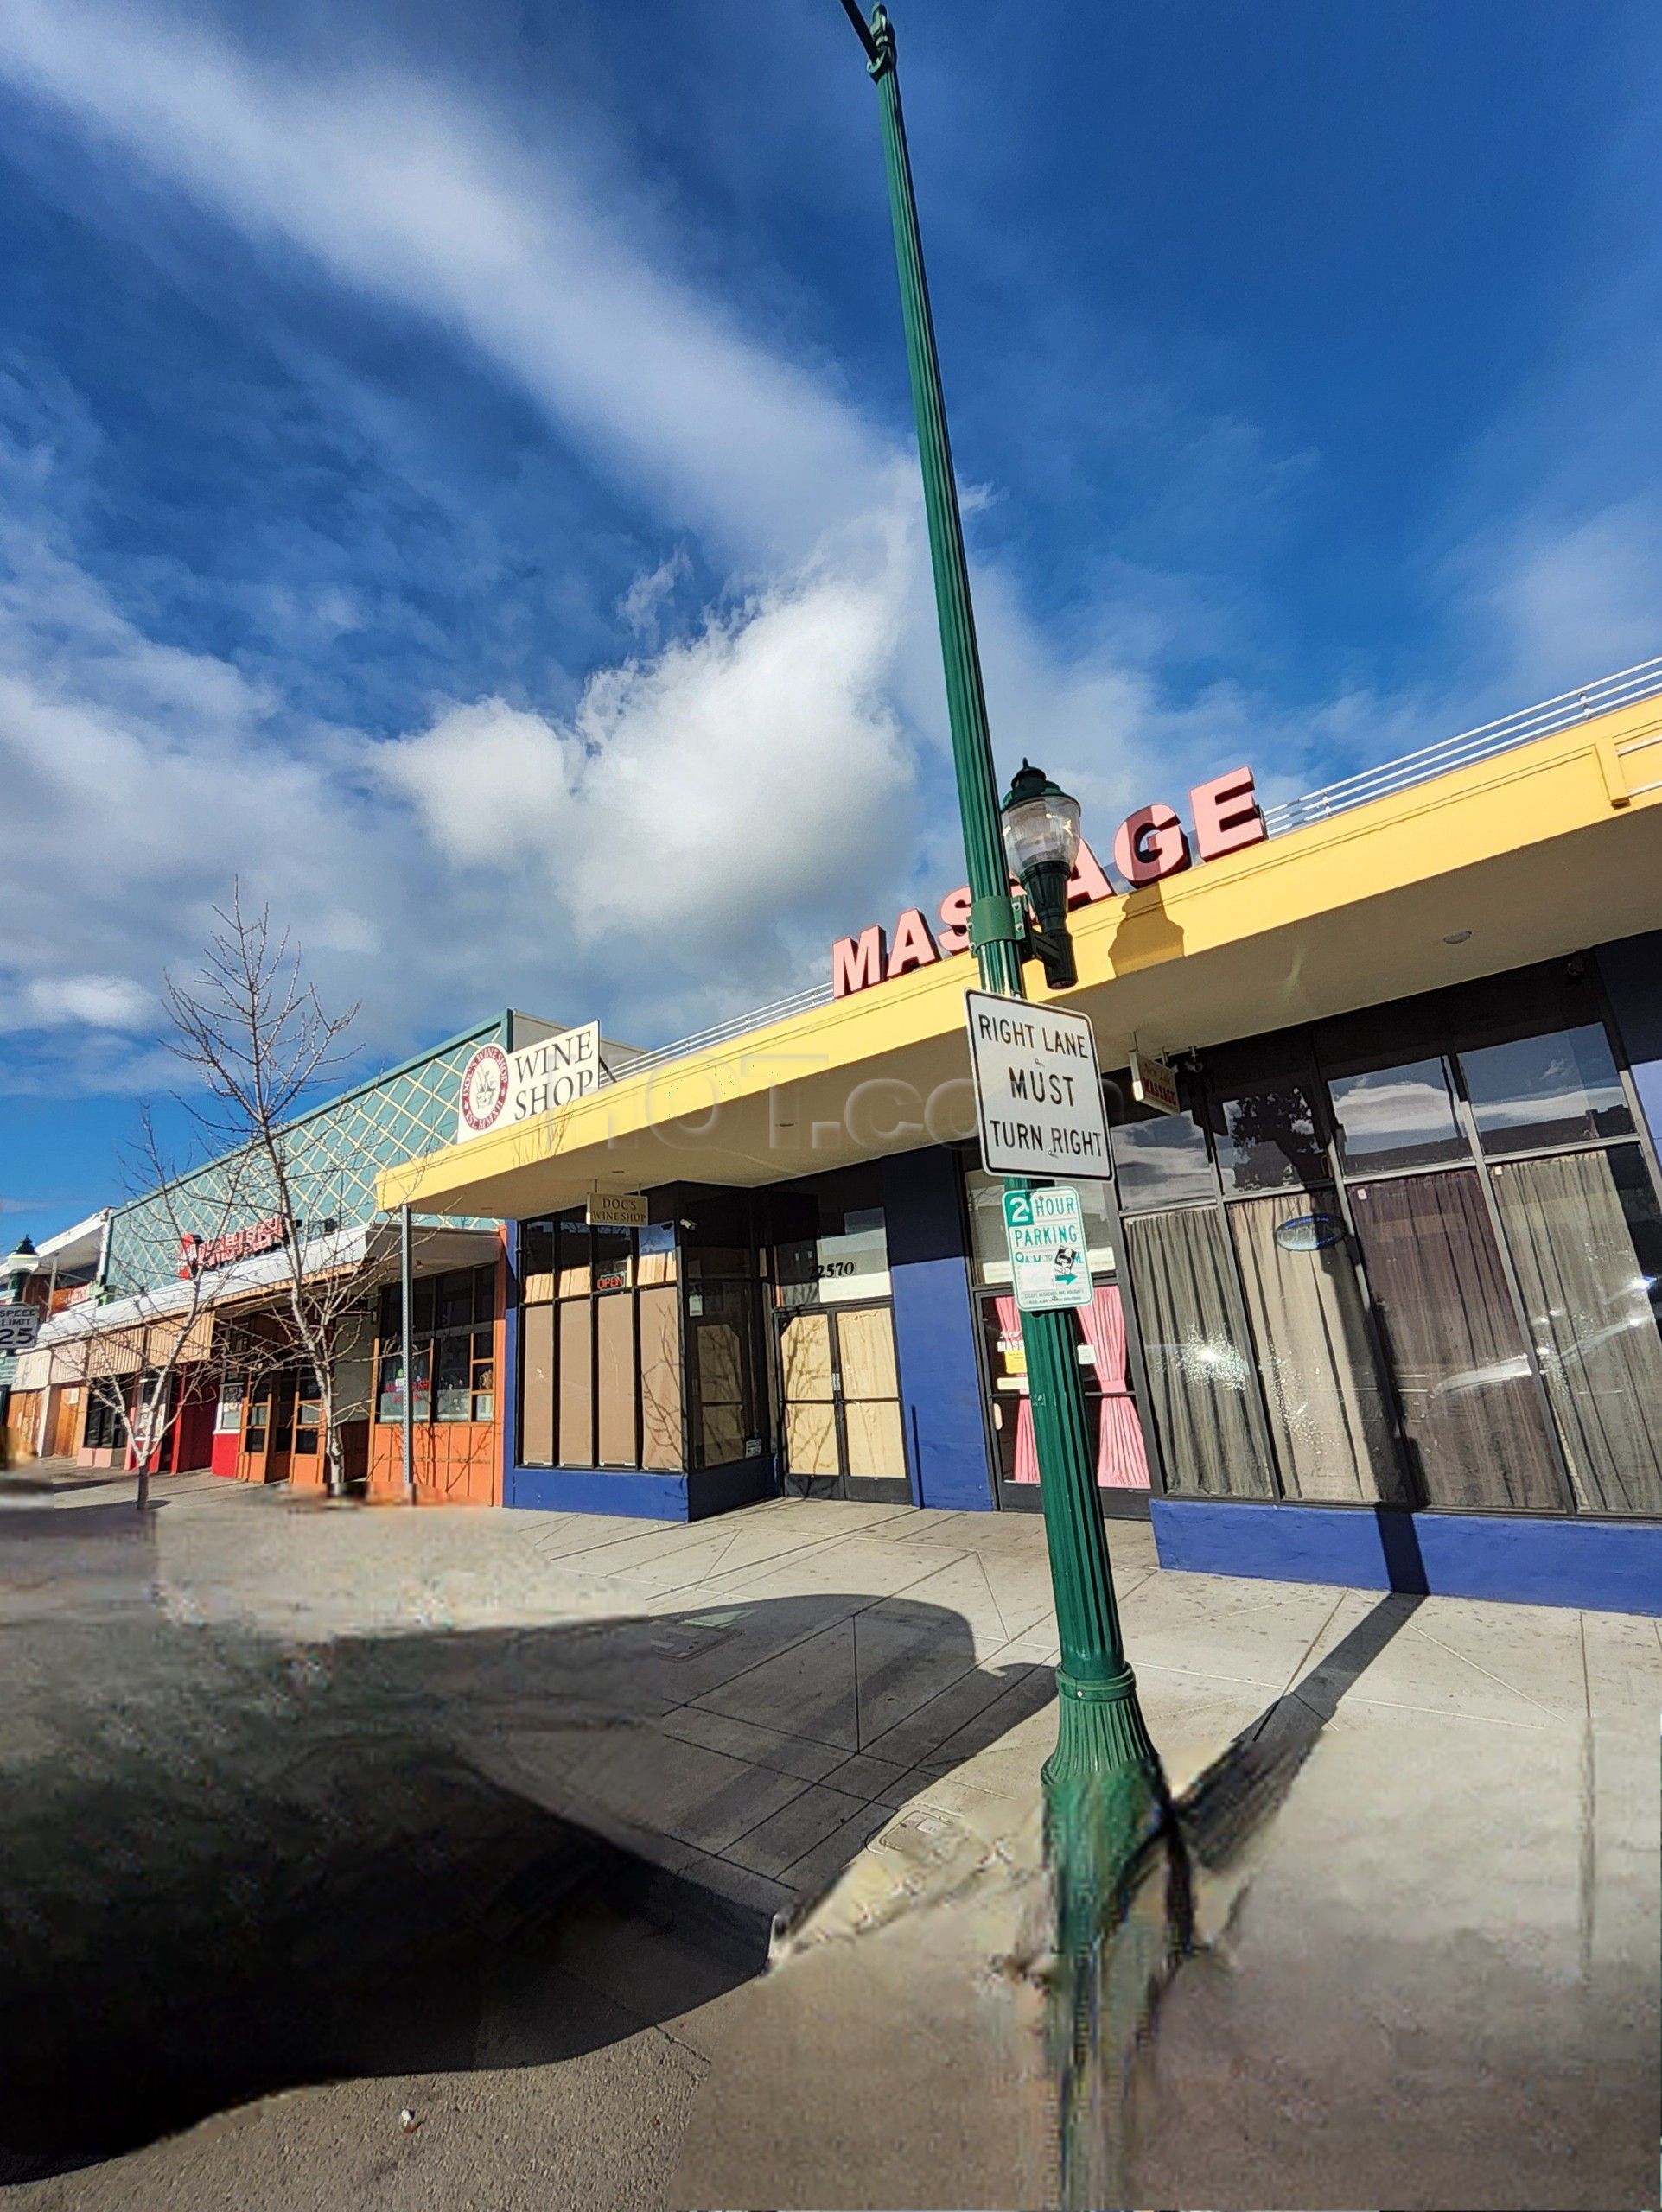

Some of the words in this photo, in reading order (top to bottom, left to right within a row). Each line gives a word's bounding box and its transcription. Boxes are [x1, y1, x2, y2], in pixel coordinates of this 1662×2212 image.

[831, 765, 1265, 1000] MASAGE
[978, 1014, 1034, 1048] RIGHT
[1042, 1027, 1089, 1058] LANE
[477, 1046, 498, 1063] WINE
[497, 1051, 508, 1083] SHOP
[514, 1032, 594, 1084] WINE
[514, 1069, 594, 1121] SHOP
[1009, 1066, 1073, 1107] MUST
[990, 1120, 1043, 1151] TURN
[1051, 1127, 1102, 1157] RIGHT
[602, 1198, 637, 1211] DOC'S
[1009, 1197, 1030, 1223] 2
[1035, 1198, 1074, 1217] HOUR
[592, 1211, 618, 1222] WINE
[621, 1211, 646, 1224] SHOP
[1015, 1224, 1078, 1247] PARKING
[597, 1274, 623, 1290] OPEN
[809, 1262, 855, 1280] 22570
[0, 1309, 36, 1318] SPEED
[2, 1318, 32, 1327] LIMIT
[0, 1327, 34, 1344] 25
